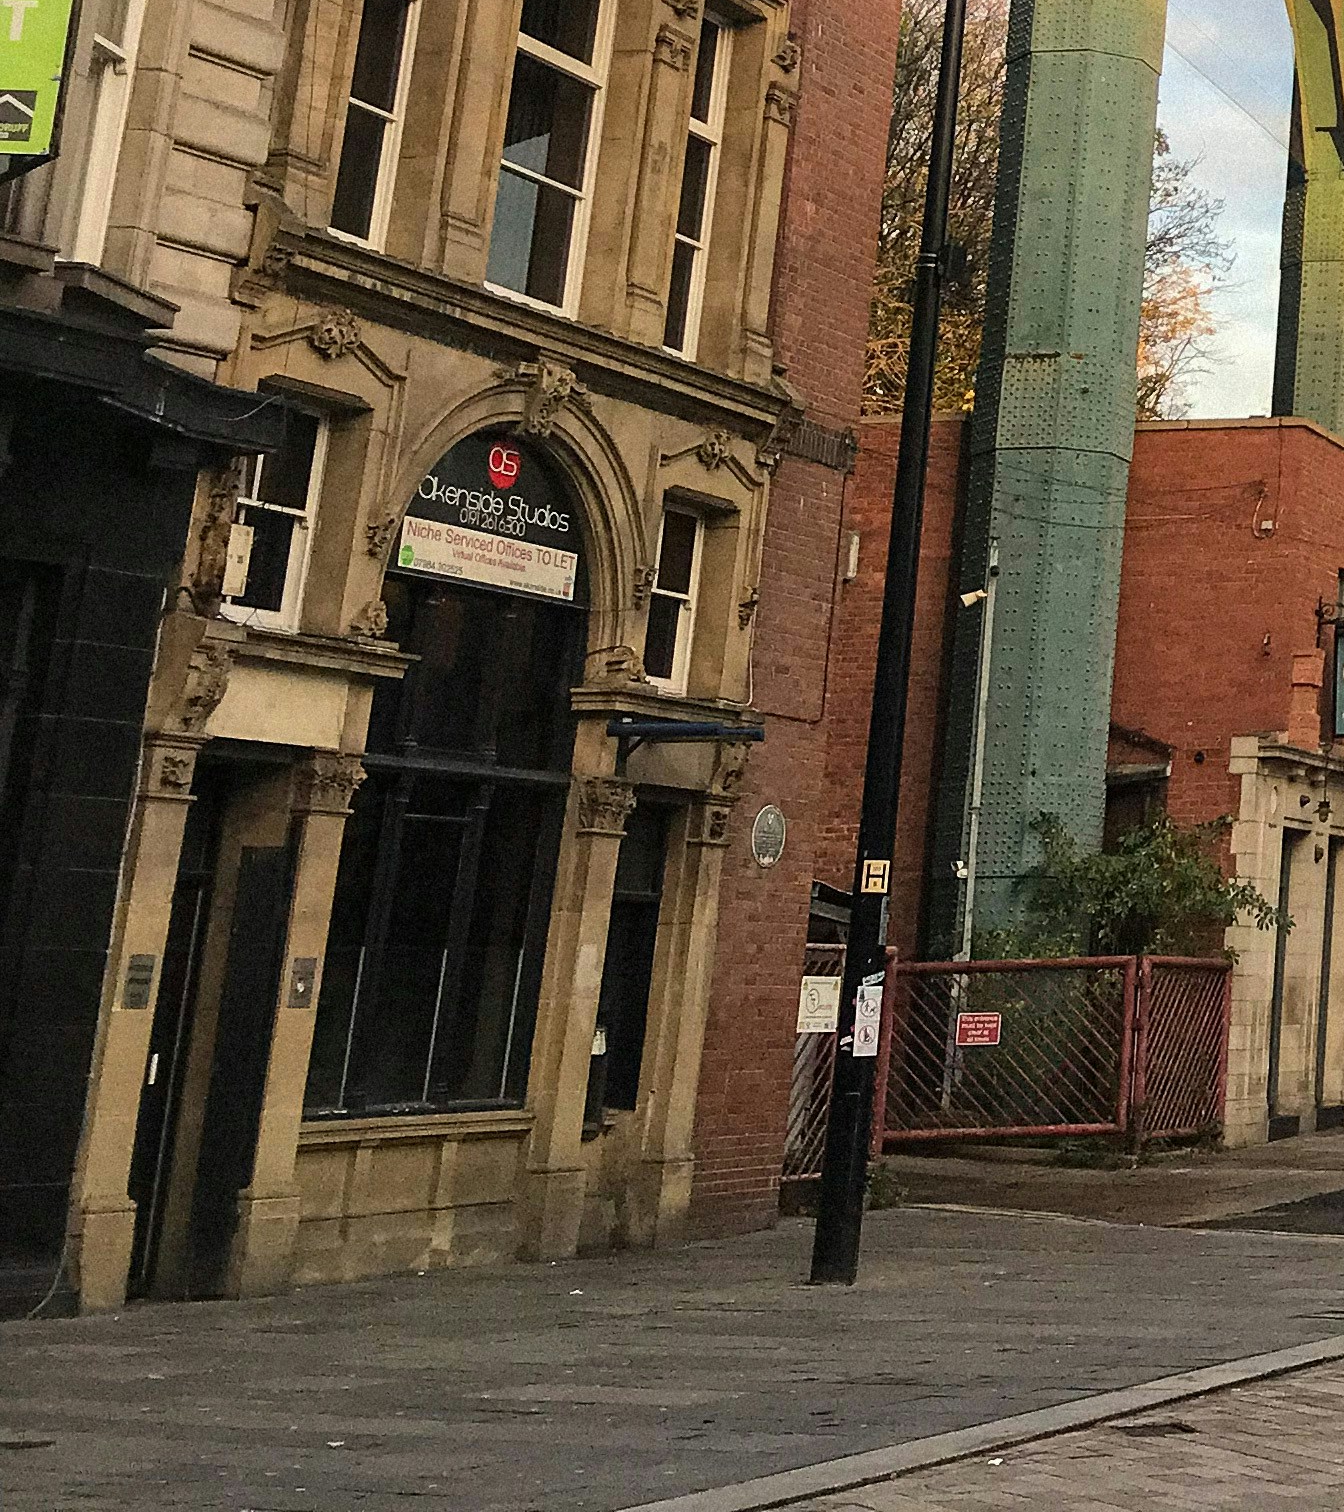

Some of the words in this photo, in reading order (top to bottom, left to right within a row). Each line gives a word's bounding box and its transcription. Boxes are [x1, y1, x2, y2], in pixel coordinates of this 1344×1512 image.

[406, 520, 442, 541] Niche
[445, 528, 494, 553] Serviced
[496, 540, 533, 563] Offices
[536, 548, 552, 566] TO
[553, 553, 576, 571] LET
[865, 863, 887, 890] H
